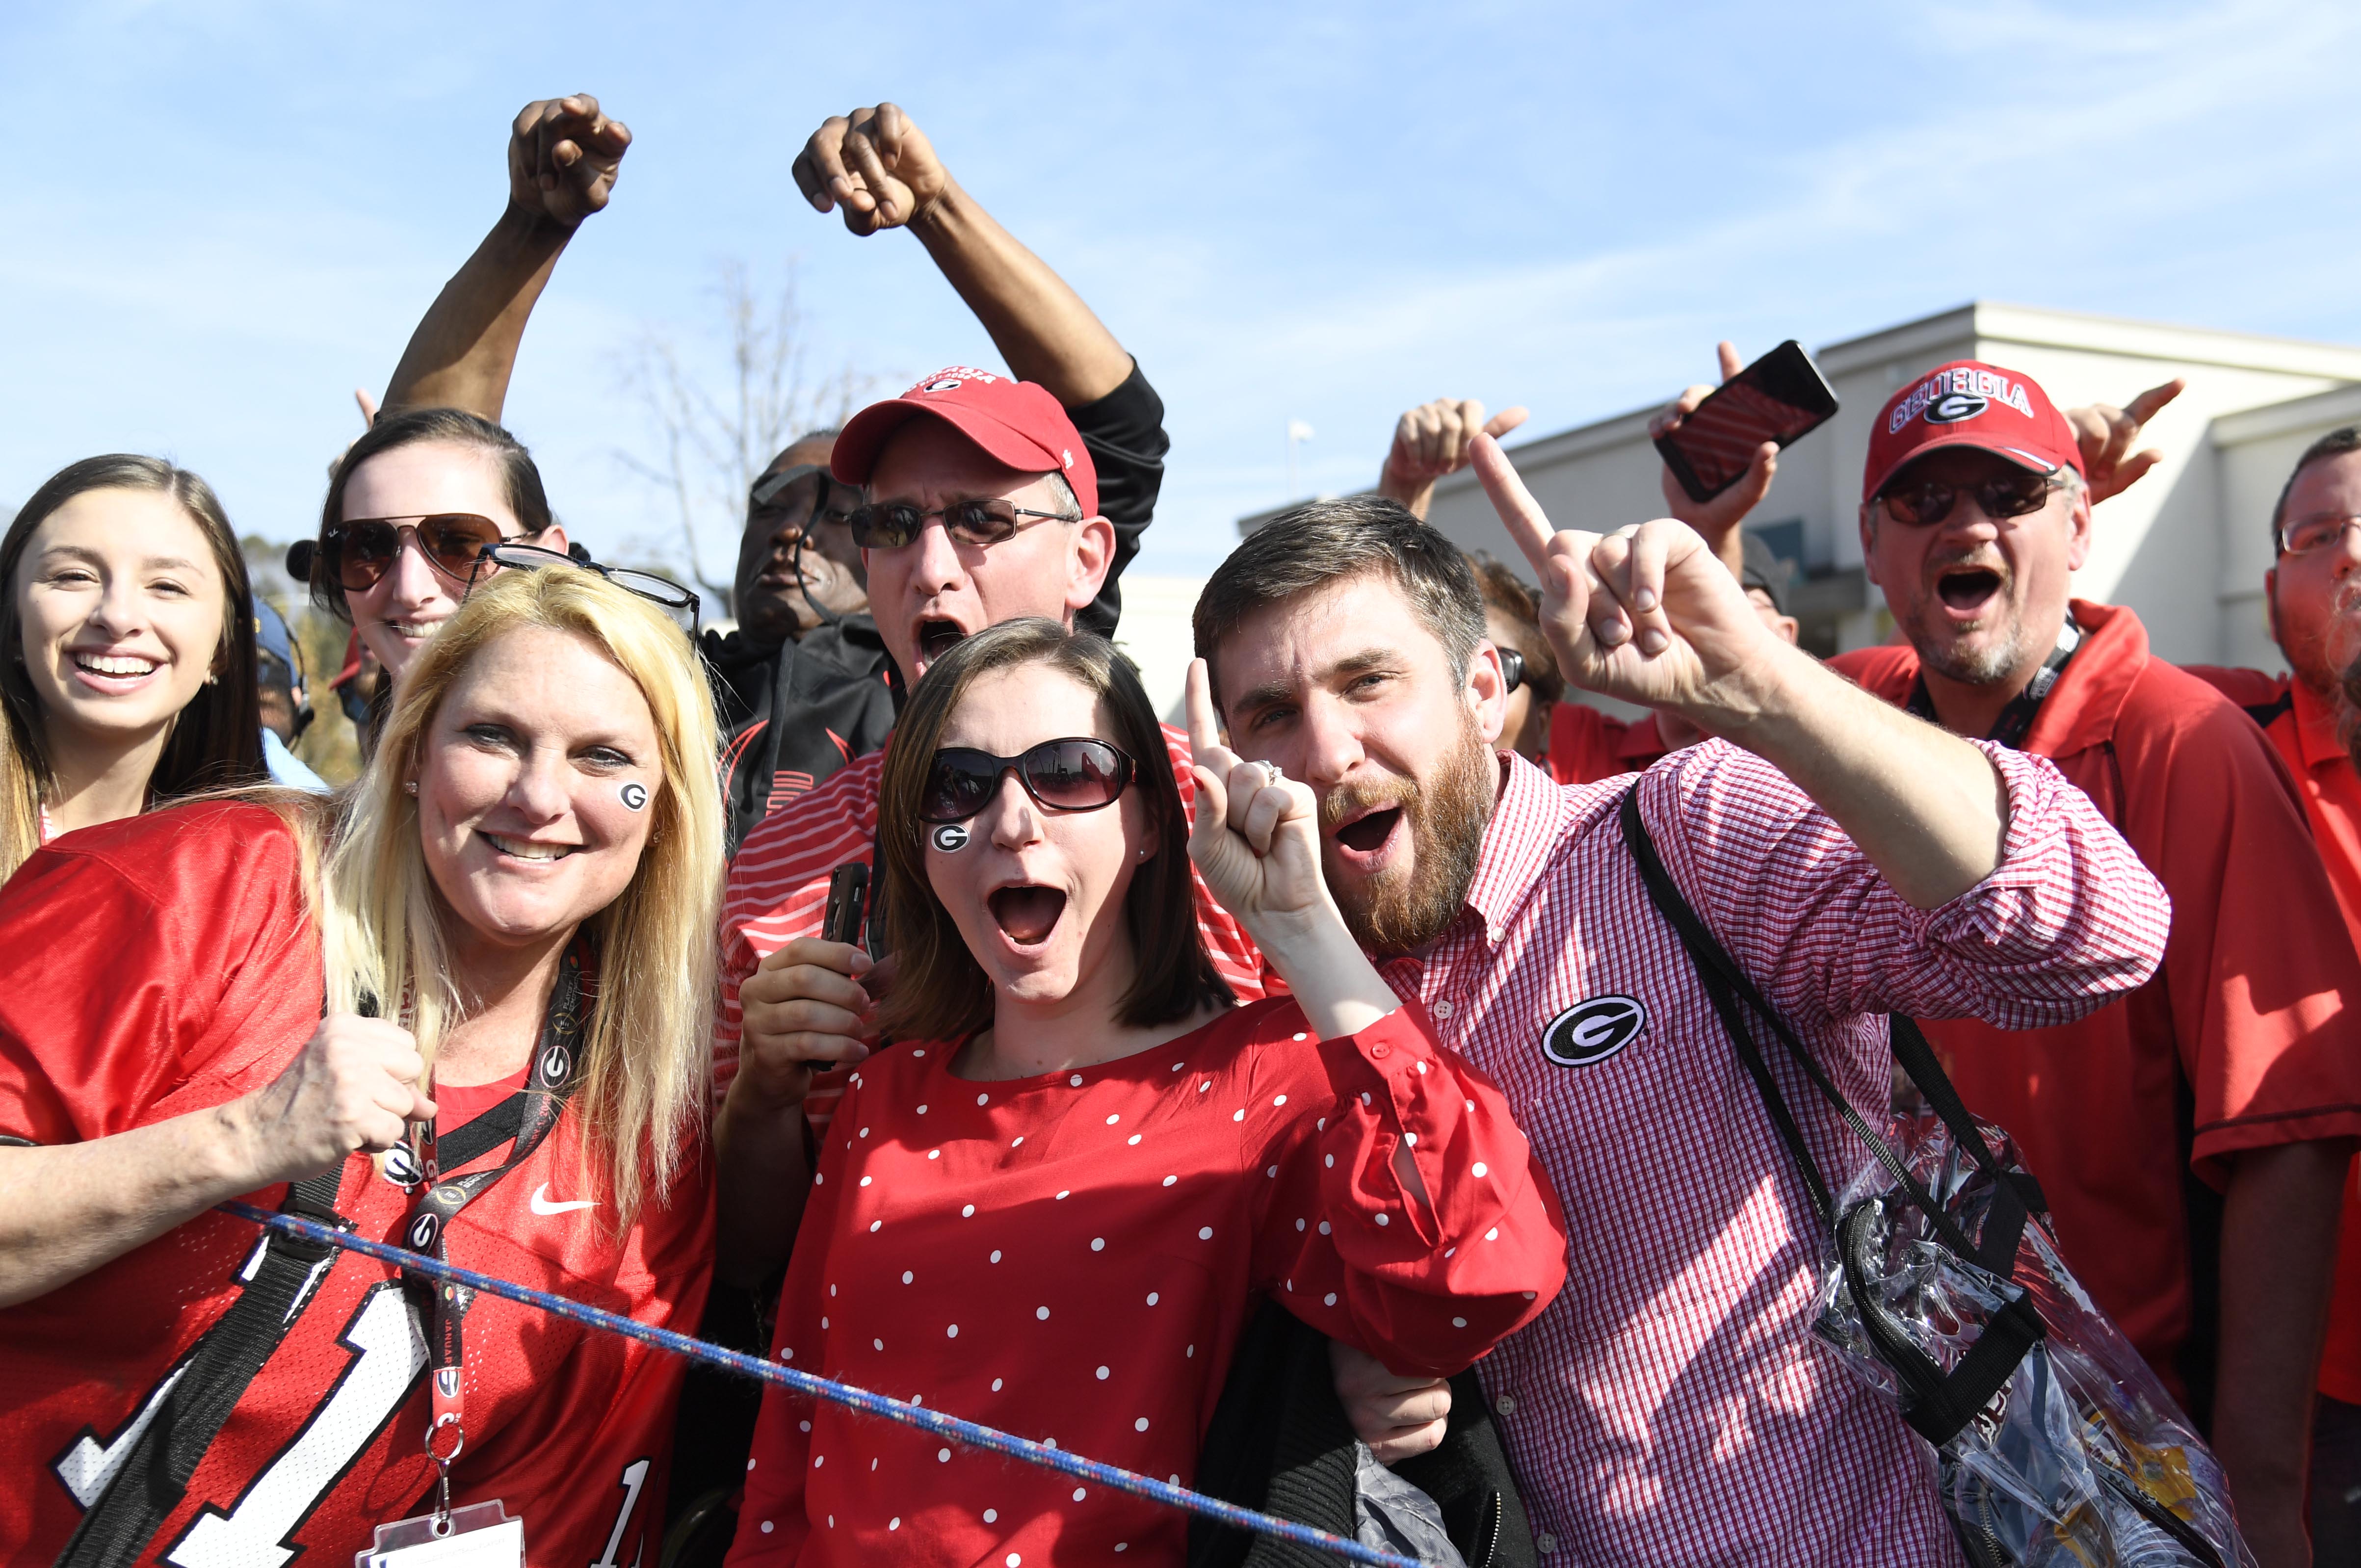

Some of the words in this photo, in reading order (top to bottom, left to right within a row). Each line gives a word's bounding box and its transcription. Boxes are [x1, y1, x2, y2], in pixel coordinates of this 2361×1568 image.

[1889, 366, 2034, 434] GEORGIA
[1923, 392, 1990, 424] G
[617, 781, 649, 812] G
[932, 824, 970, 853] G
[1542, 994, 1647, 1068] G
[540, 1045, 571, 1088] G
[408, 1210, 439, 1256] G
[444, 1319, 452, 1367] JANUAR
